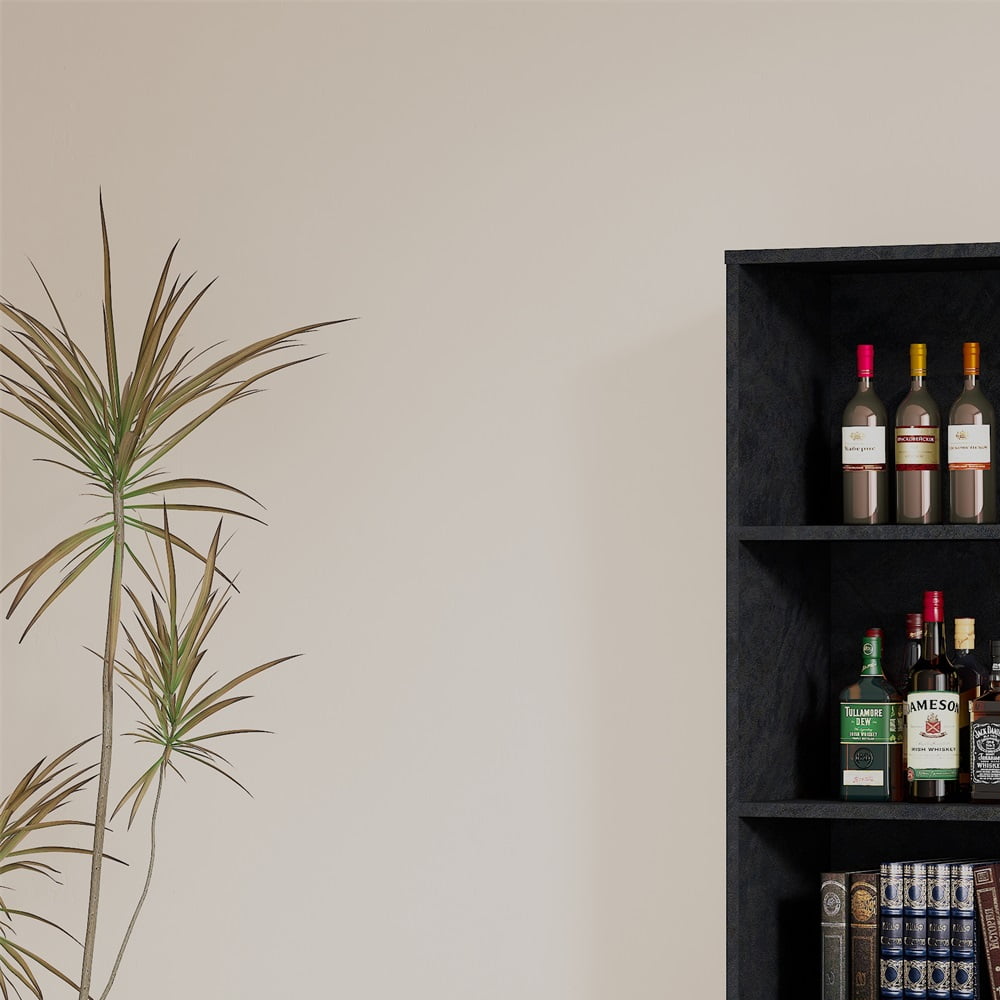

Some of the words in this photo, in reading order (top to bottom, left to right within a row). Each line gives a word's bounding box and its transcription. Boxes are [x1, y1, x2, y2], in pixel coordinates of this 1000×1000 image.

[845, 706, 883, 718] TULLAMORE
[856, 717, 871, 726] DEW
[974, 728, 987, 739] JACK
